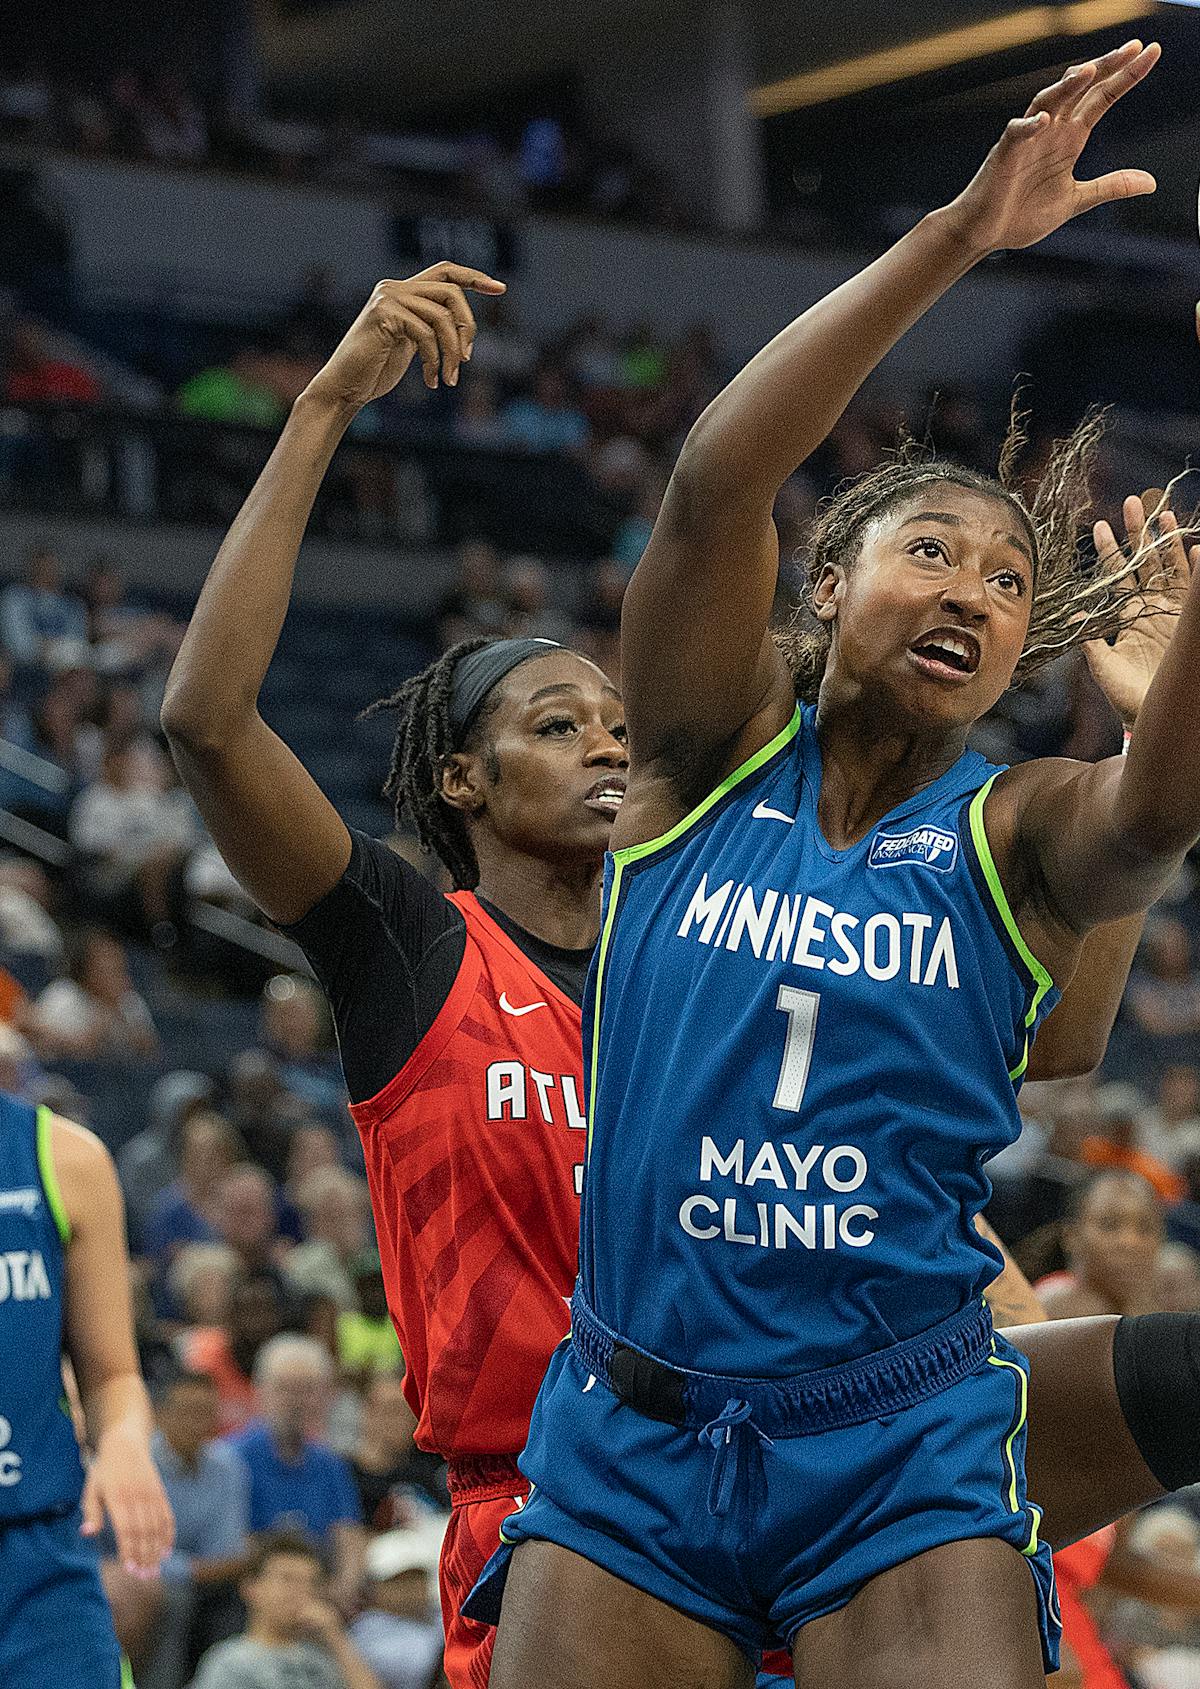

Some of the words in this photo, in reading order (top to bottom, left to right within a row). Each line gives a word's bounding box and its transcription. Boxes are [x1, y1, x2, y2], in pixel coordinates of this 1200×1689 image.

[877, 830, 955, 852] FEDERATED
[676, 872, 960, 989] MINNESOTA
[772, 984, 821, 1113] 1
[486, 1060, 587, 1130] ATL
[699, 1136, 868, 1193] MAYO
[679, 1194, 879, 1250] CLINIC
